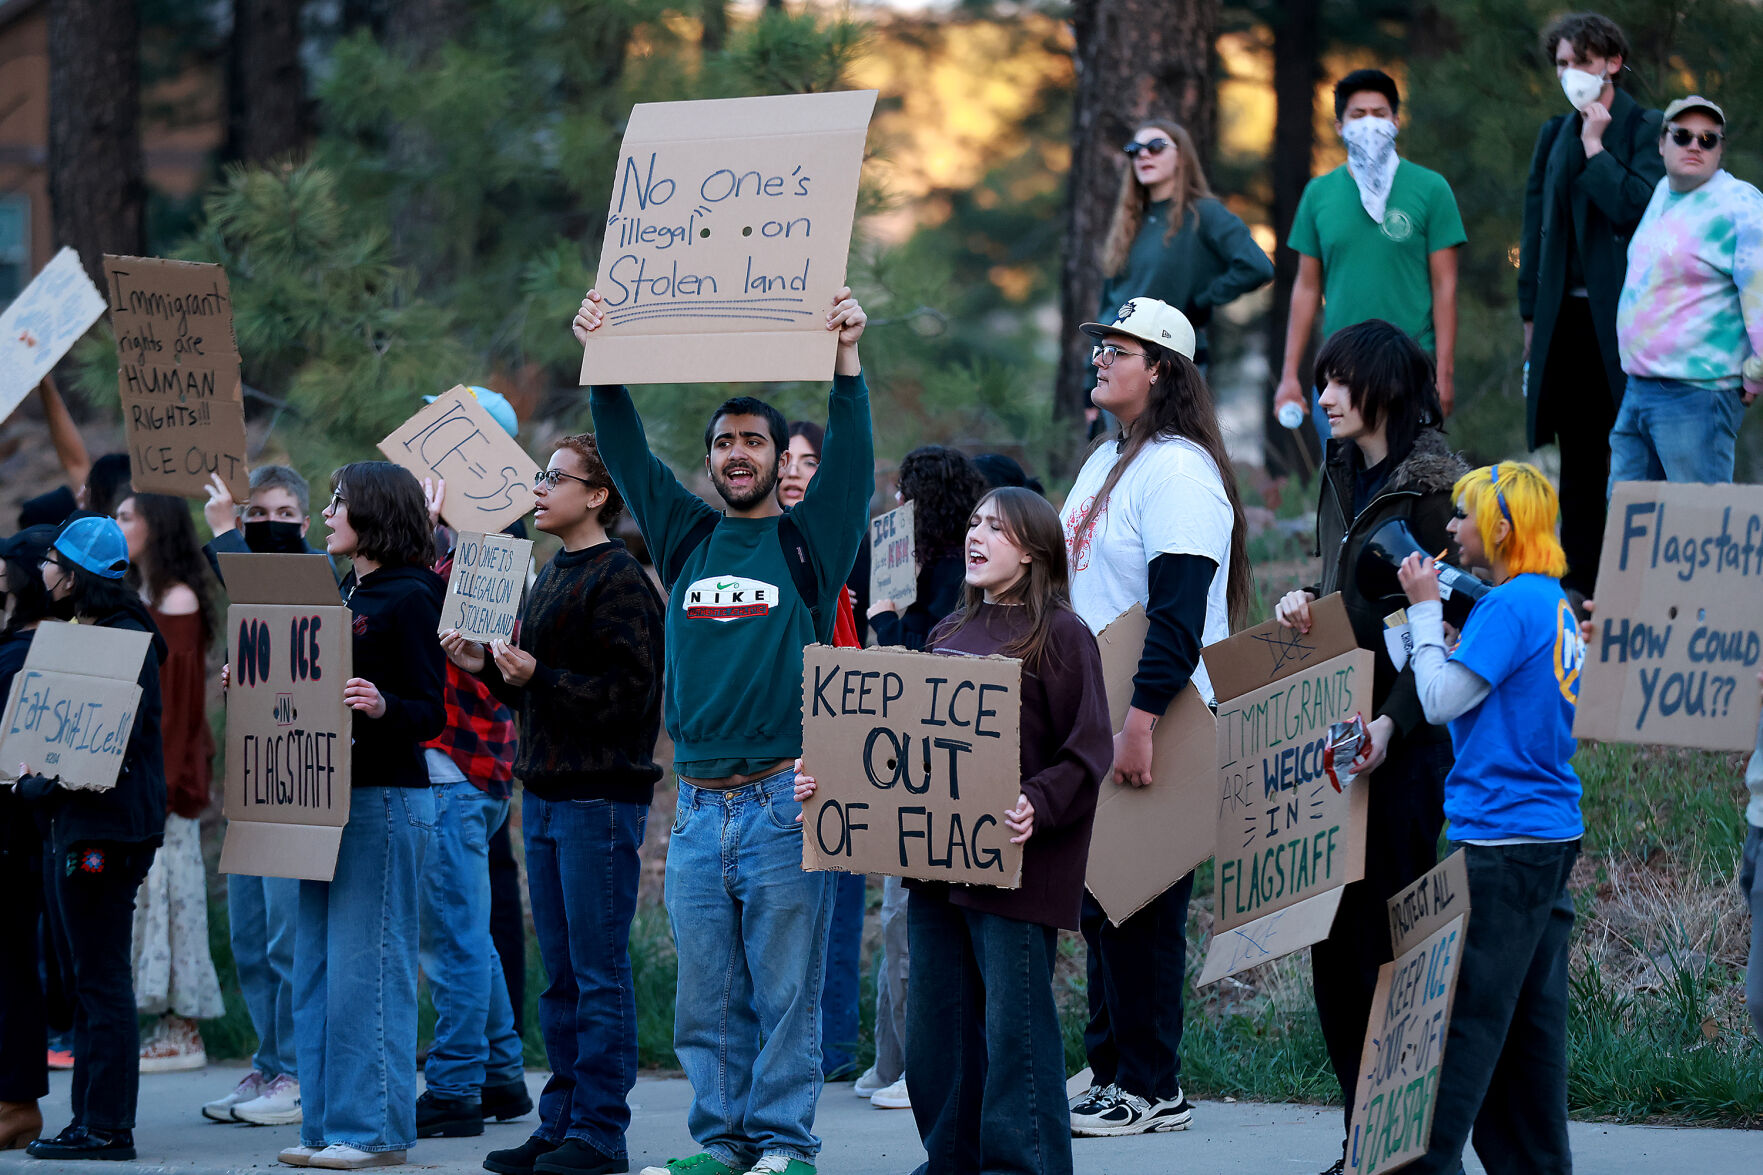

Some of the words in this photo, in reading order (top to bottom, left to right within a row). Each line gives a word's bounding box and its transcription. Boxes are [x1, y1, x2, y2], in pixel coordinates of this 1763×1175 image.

[617, 152, 677, 213] No
[700, 164, 812, 203] One's
[608, 205, 713, 249] "illegal"
[761, 217, 812, 238] on
[112, 270, 227, 337] Immigrant
[603, 254, 718, 307] Stolen
[744, 255, 810, 294] land
[119, 322, 163, 367] rights
[175, 336, 204, 355] are
[123, 364, 216, 397] HUMAN
[135, 445, 176, 476] ICE
[184, 445, 241, 481] OUT
[459, 542, 478, 567] NO
[478, 544, 500, 570] ONE
[497, 549, 514, 573] IS
[689, 608, 728, 616] AUTHENTIC
[729, 606, 765, 615] ATHLETIC
[690, 590, 765, 604] NIKE
[237, 616, 271, 689] NO
[289, 614, 322, 684] ICE
[10, 671, 51, 735] Eat
[278, 697, 291, 724] IN
[812, 664, 904, 718] KEEP
[920, 677, 1009, 739] ICE
[1220, 664, 1355, 770] IMMIGRANTS
[1636, 667, 1737, 731] YOU??
[243, 728, 337, 810] FLAGSTAFF
[862, 726, 973, 800] OUT
[1219, 764, 1256, 821] ARE
[1262, 736, 1327, 800] WELCO
[816, 799, 870, 858] OF
[898, 806, 1005, 873] FLAG
[1265, 798, 1299, 839] IN
[1221, 825, 1340, 921] FLAGSTAFF
[1390, 876, 1430, 947] PROTECT
[1433, 869, 1456, 917] ALL
[1383, 950, 1427, 1032] KEEP
[1421, 929, 1458, 1007] ICE
[1375, 1012, 1412, 1087] OUT
[1415, 1009, 1443, 1072] OF
[1357, 1064, 1440, 1175] FLAGSTAF
